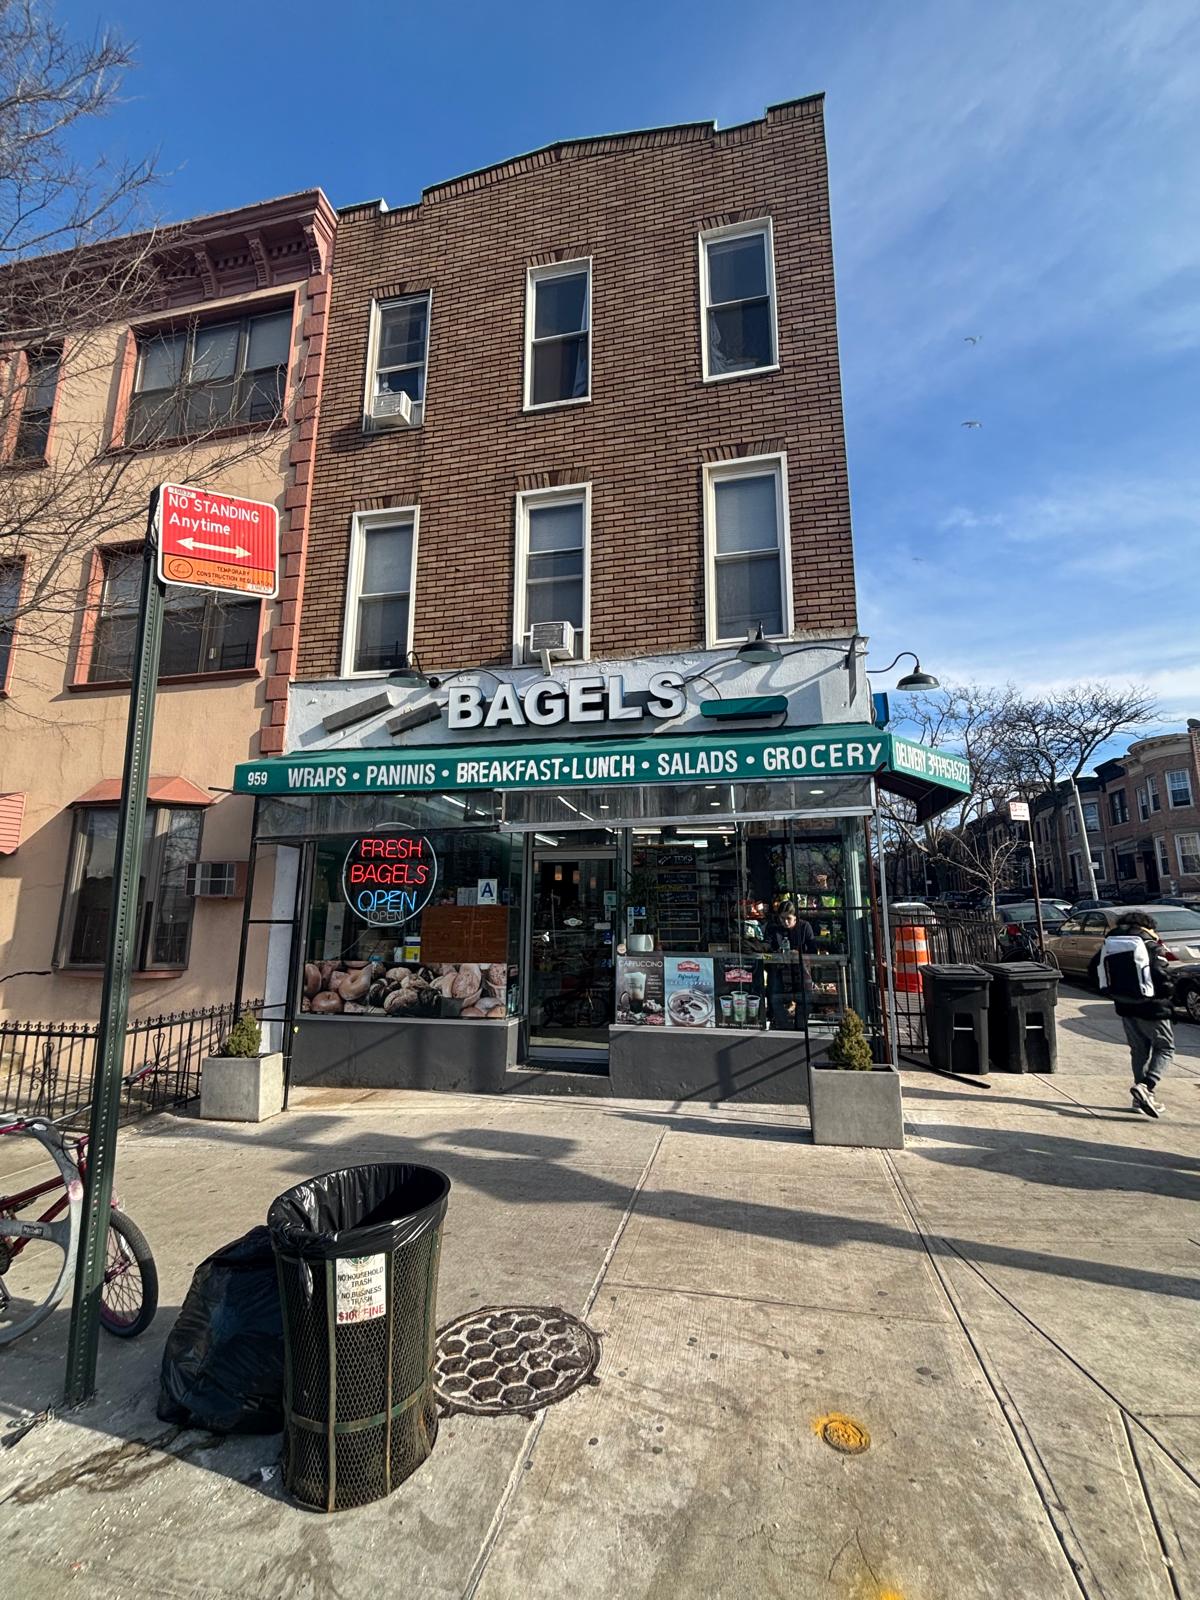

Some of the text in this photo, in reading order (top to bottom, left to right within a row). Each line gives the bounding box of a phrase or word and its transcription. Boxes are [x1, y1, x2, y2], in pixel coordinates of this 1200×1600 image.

[169, 494, 259, 523] NO STANDING
[169, 512, 231, 535] Anytime
[196, 570, 238, 582] CONSTRUCTION
[217, 566, 250, 576] TEMPORARY
[448, 671, 687, 729] BAGELS
[895, 741, 927, 773] DELIVERY
[247, 742, 883, 788] 959 WRAPS PANINIS BREAKFAST LUNCH SALADS GROCERY
[361, 839, 423, 858] FRESH
[351, 864, 429, 884] BAGELS
[481, 882, 494, 897] A
[357, 890, 417, 912] OPEN
[370, 909, 402, 921] OPEN
[618, 960, 663, 968] CAPPUCCINO
[338, 1267, 384, 1282] NO HOUSEHOLD
[351, 1277, 373, 1288] TRASH
[352, 1285, 382, 1298] BUSINESS
[351, 1296, 373, 1306] TRASH
[363, 1303, 384, 1317] FINE
